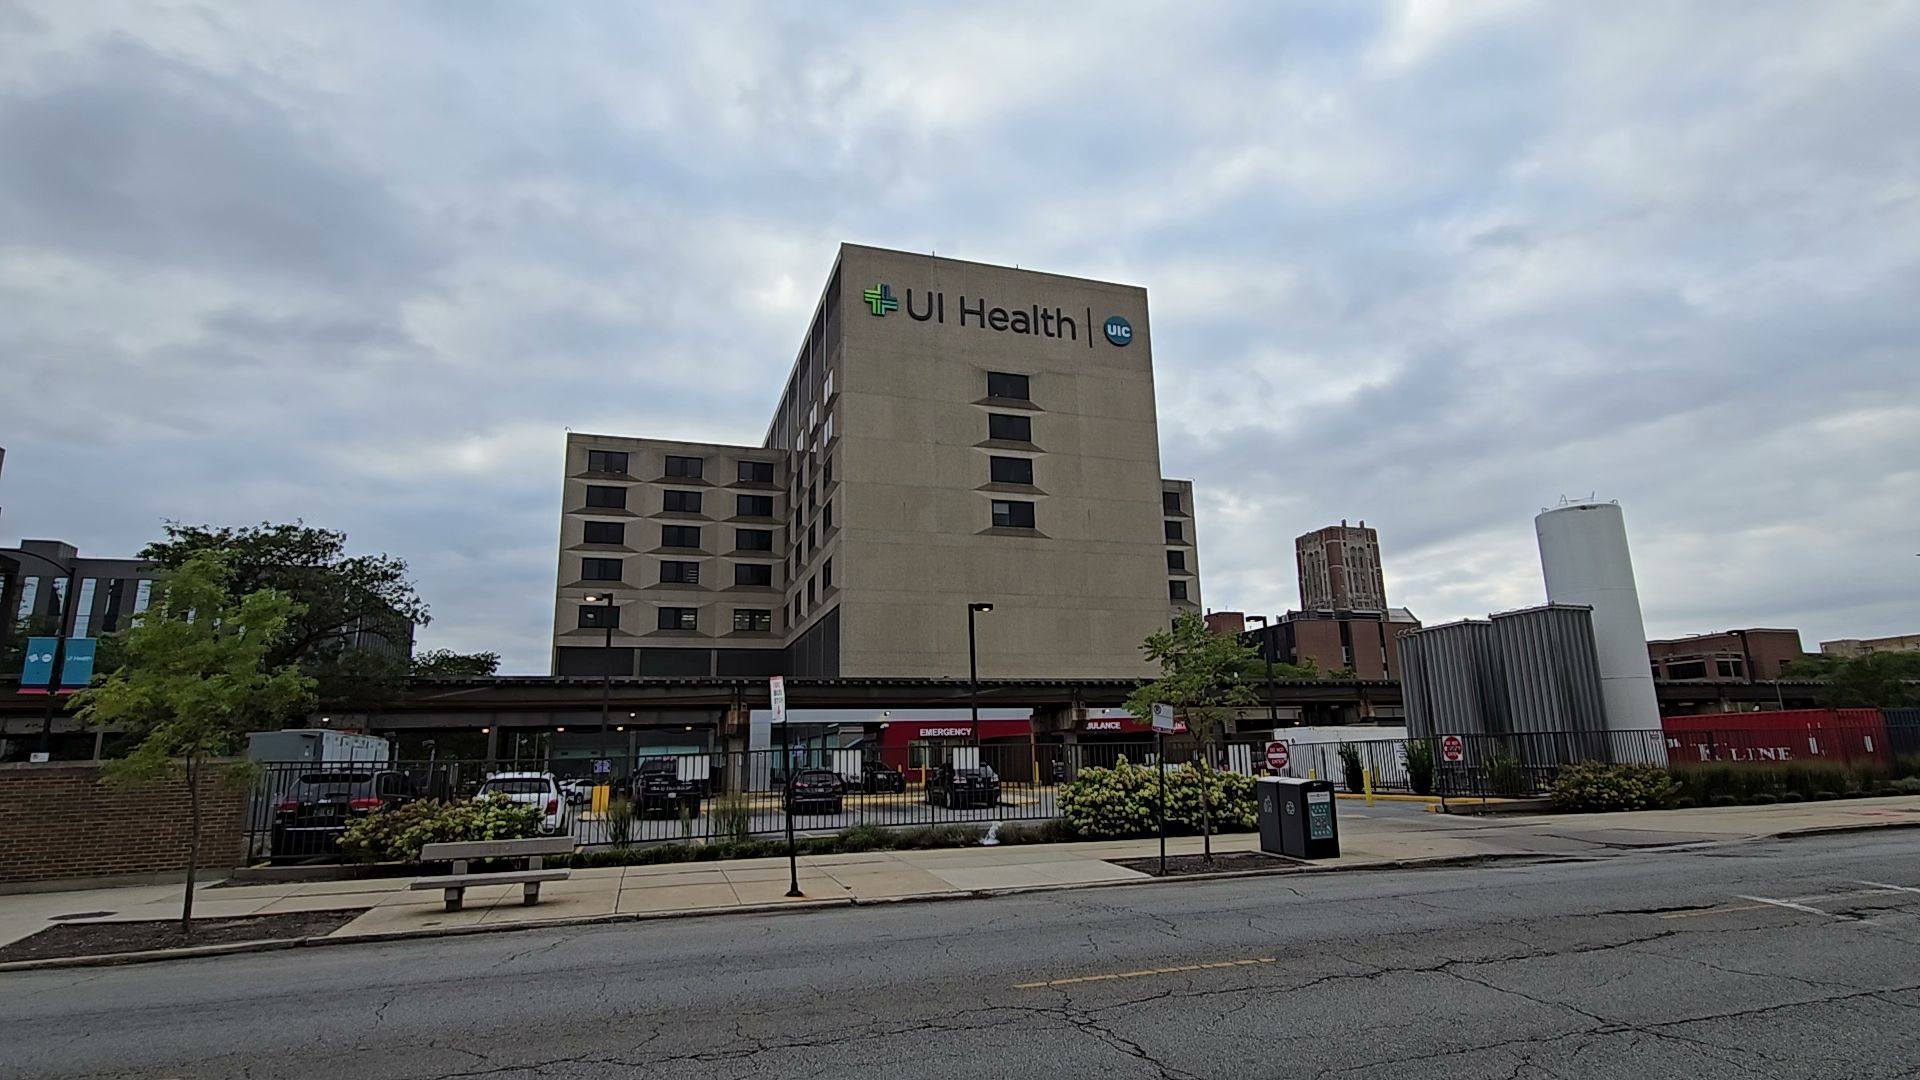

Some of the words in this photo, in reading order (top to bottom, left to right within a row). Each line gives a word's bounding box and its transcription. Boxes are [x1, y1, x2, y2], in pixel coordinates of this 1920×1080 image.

[907, 288, 943, 323] UI
[960, 295, 1076, 340] Health
[1107, 324, 1131, 338] UIC
[919, 727, 972, 737] EMERGENCY
[1729, 747, 1793, 761] LINE
